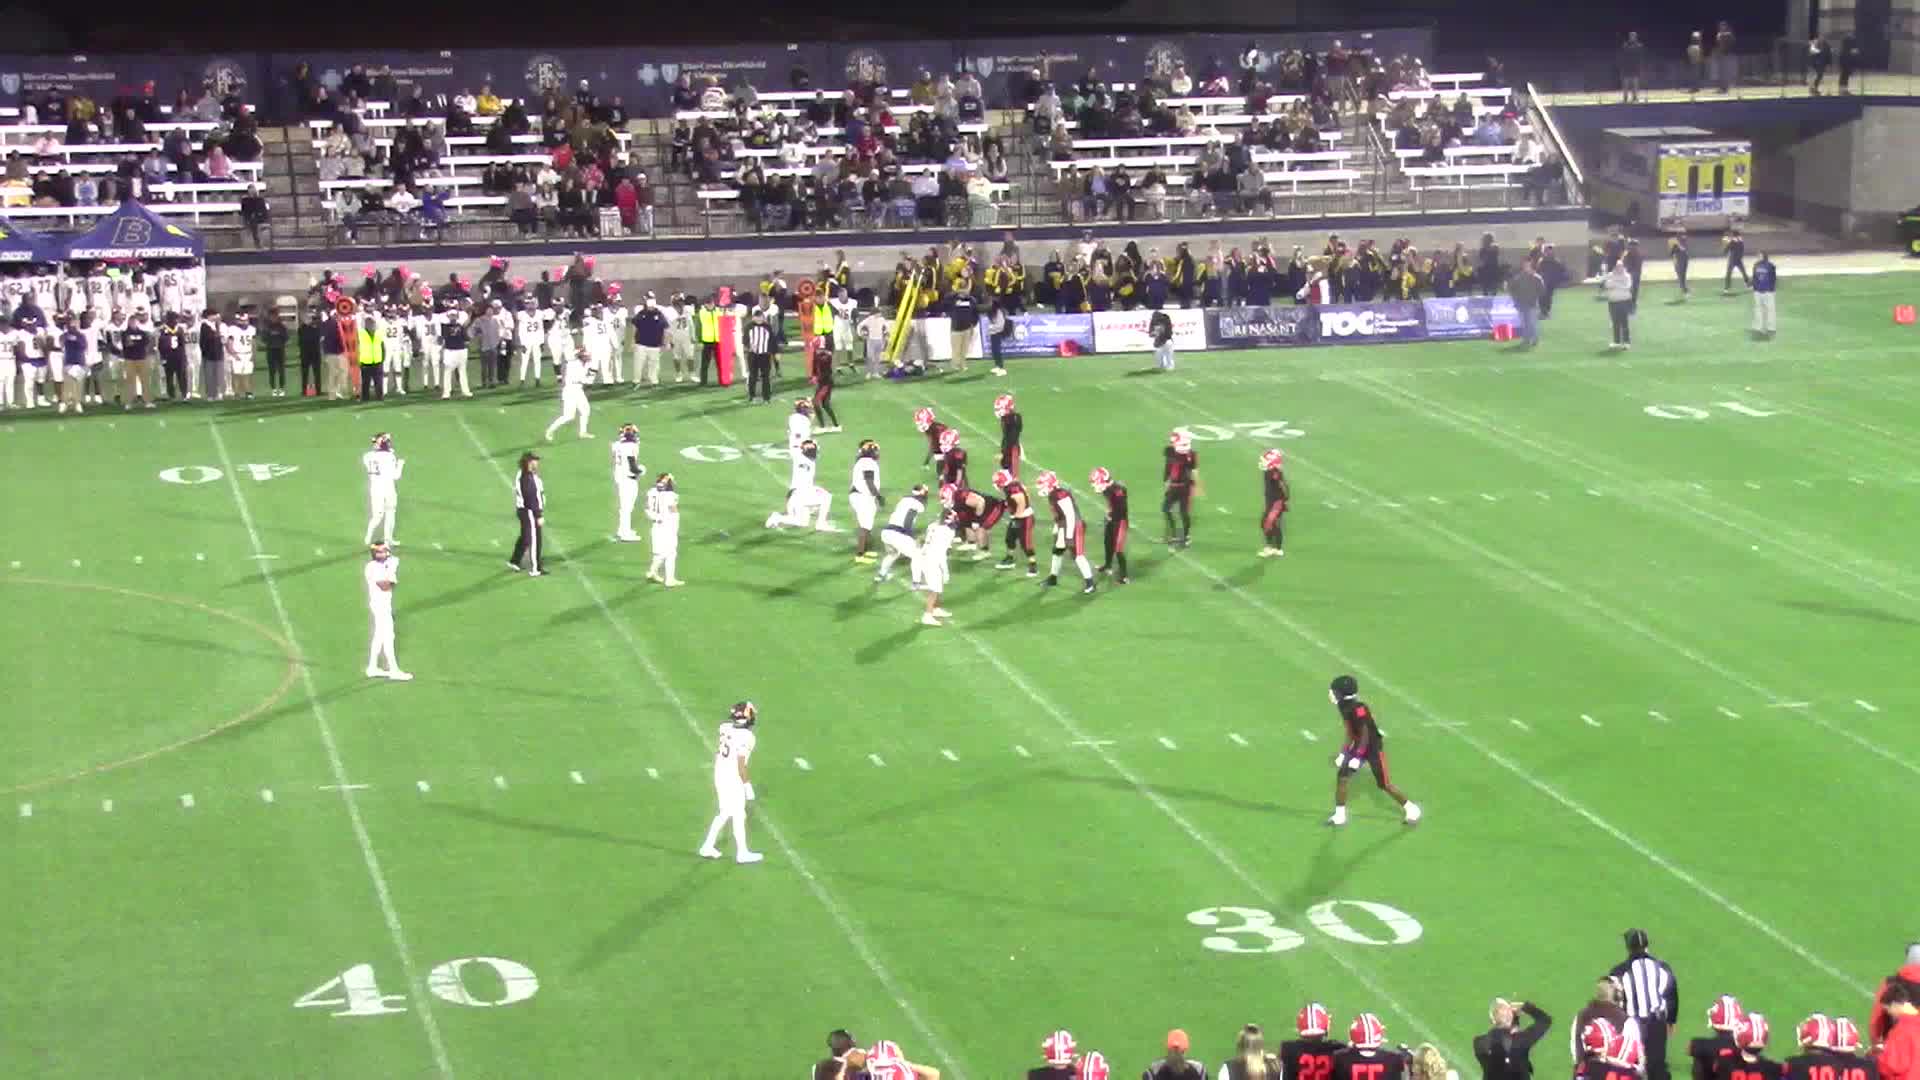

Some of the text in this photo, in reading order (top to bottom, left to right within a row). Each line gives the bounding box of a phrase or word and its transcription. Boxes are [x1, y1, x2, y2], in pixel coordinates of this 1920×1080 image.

[70, 246, 194, 258] BUCKHORN FOOTBALL
[1320, 311, 1374, 336] TOC
[1186, 900, 1423, 953] 30
[293, 956, 539, 1016] 40
